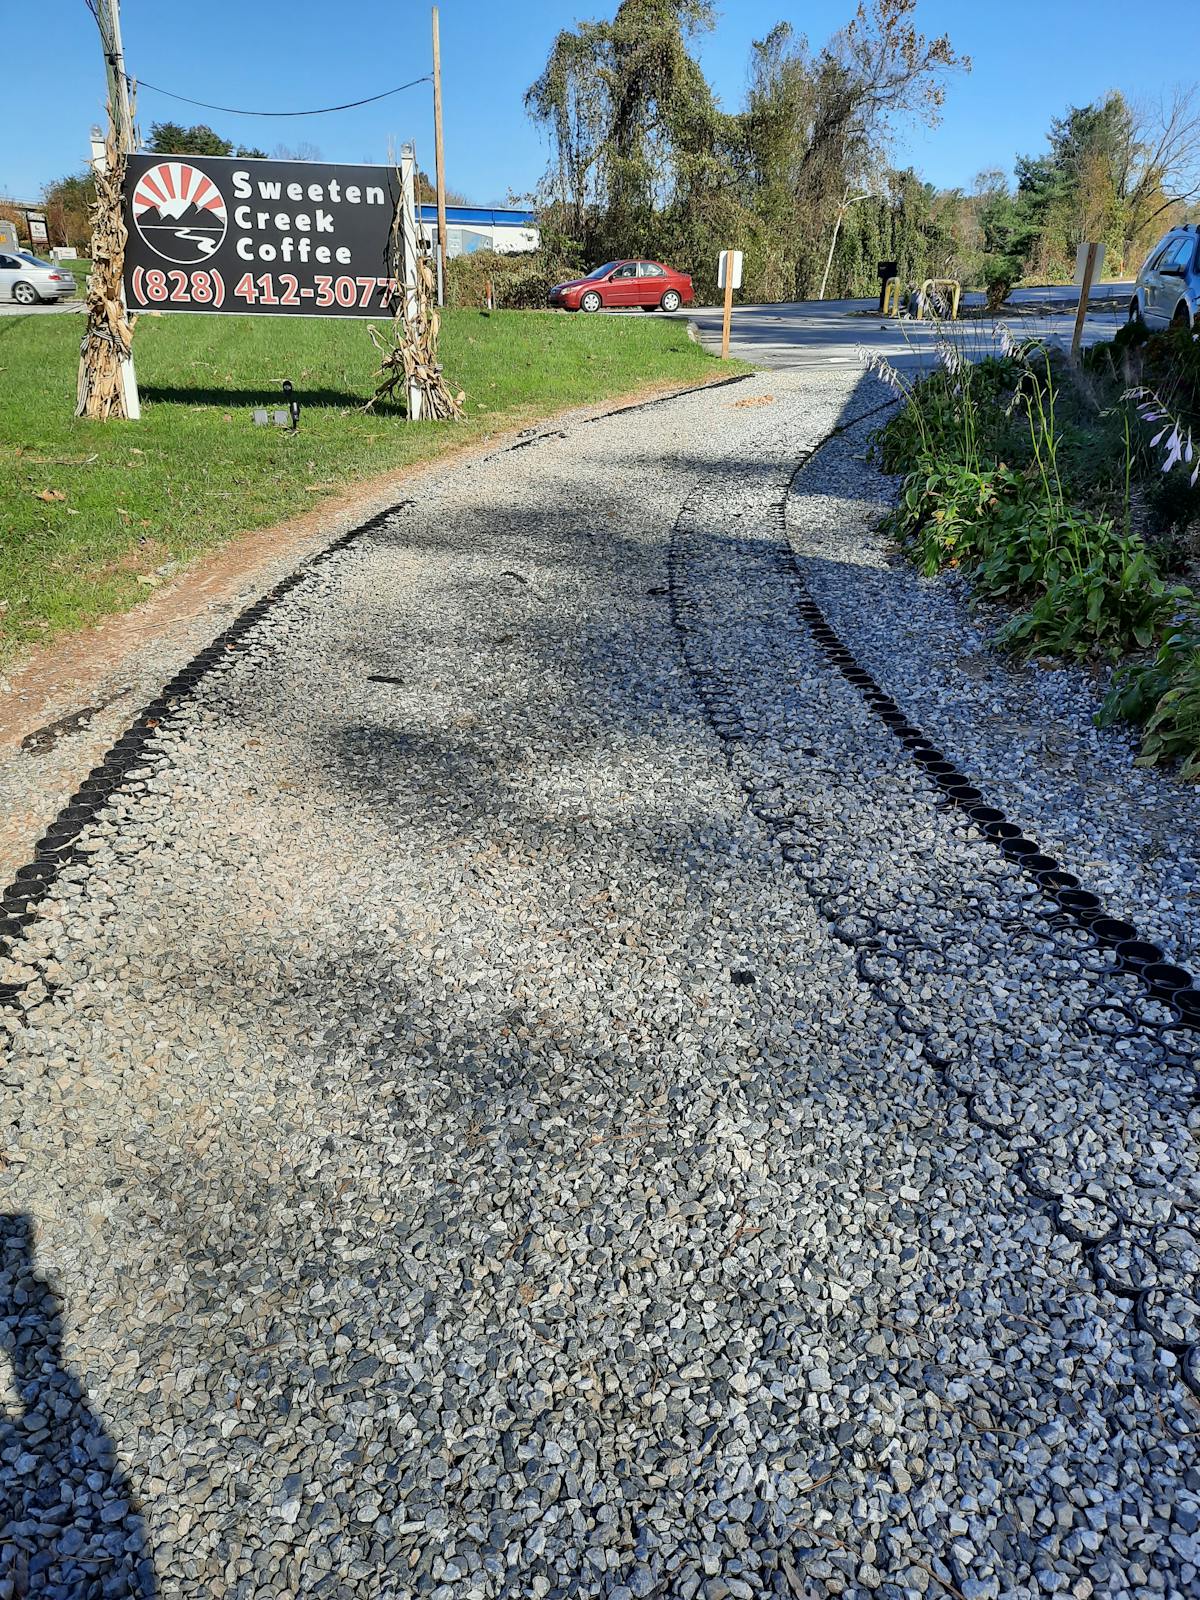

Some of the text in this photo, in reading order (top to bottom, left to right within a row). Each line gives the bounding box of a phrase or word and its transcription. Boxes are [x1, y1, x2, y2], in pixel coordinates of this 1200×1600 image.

[232, 171, 385, 205] Sweeten
[234, 205, 335, 233] Creek
[236, 237, 352, 264] Coffee
[132, 265, 398, 308] (828) 412-3077
